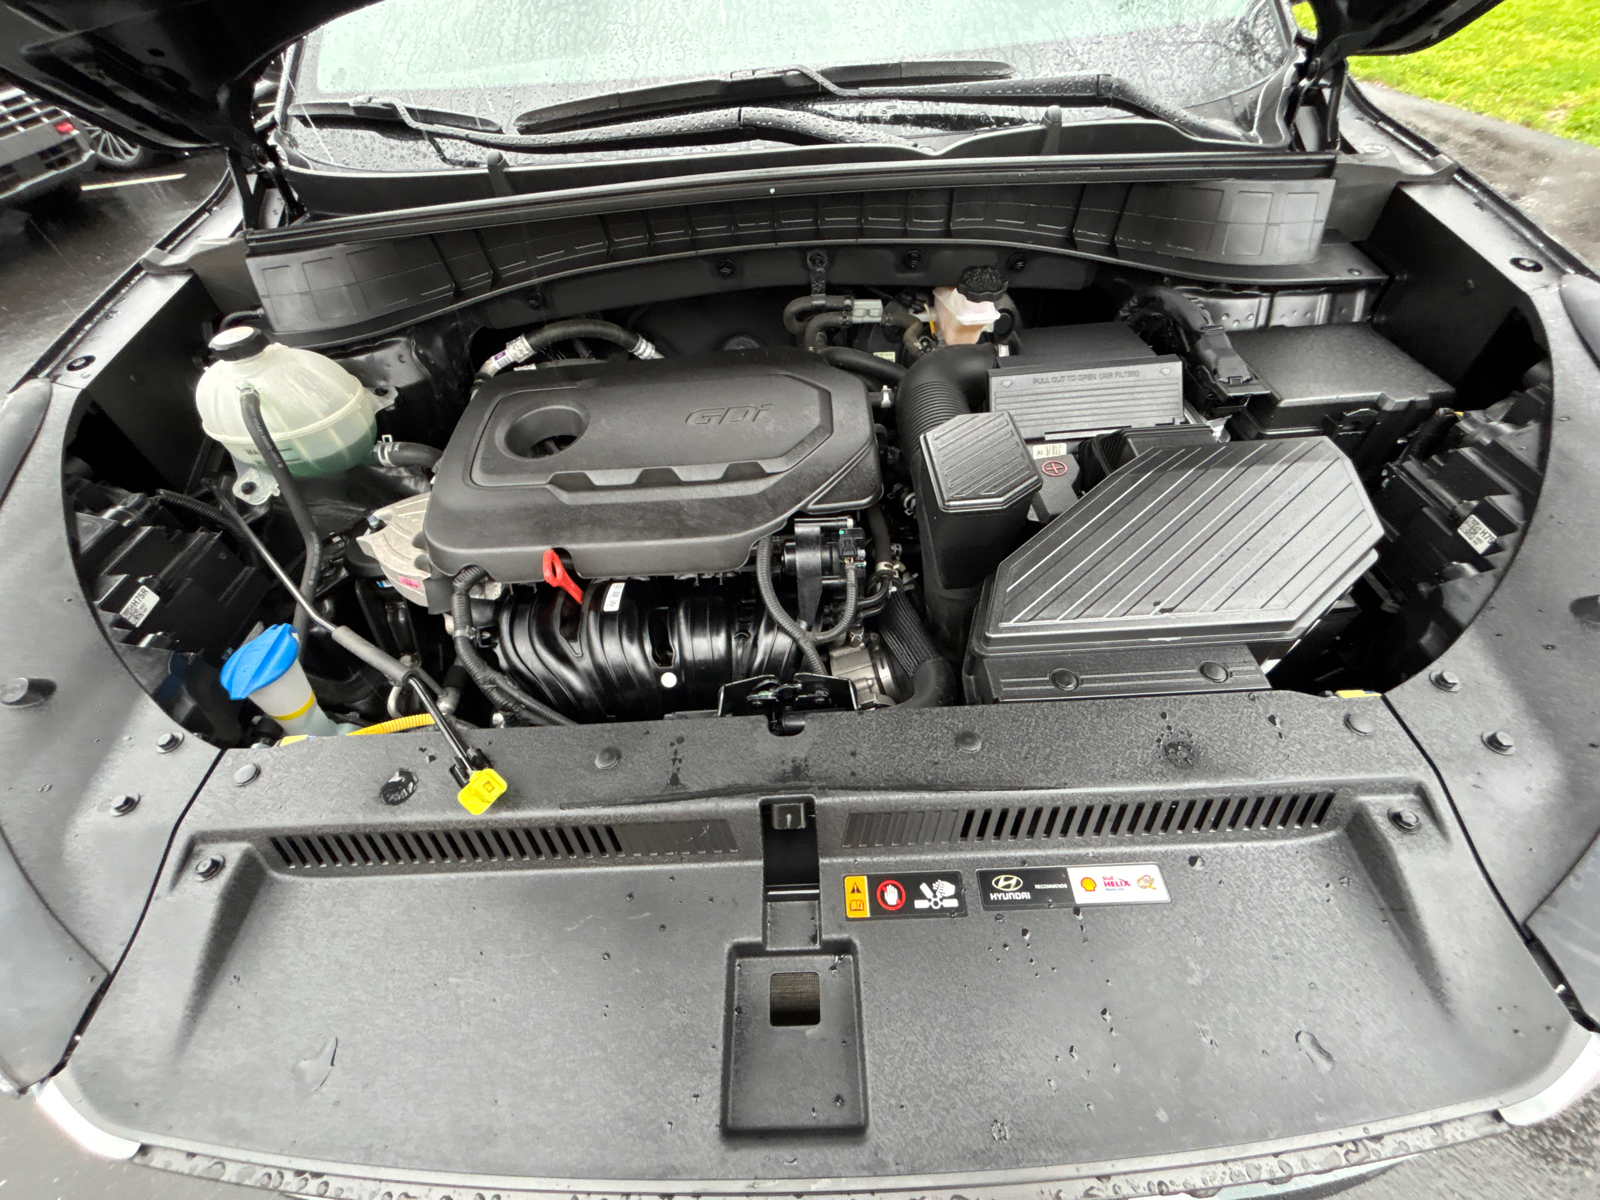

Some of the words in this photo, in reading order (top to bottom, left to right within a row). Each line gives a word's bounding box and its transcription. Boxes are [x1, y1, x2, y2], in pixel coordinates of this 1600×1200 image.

[1032, 376, 1051, 385] PULL
[1051, 375, 1066, 383] OUT
[1066, 374, 1076, 382] TO
[1077, 373, 1097, 381] OPEN
[131, 587, 150, 608] H75R
[1103, 878, 1132, 888] HELIX
[989, 891, 1032, 901] HYUNDAI
